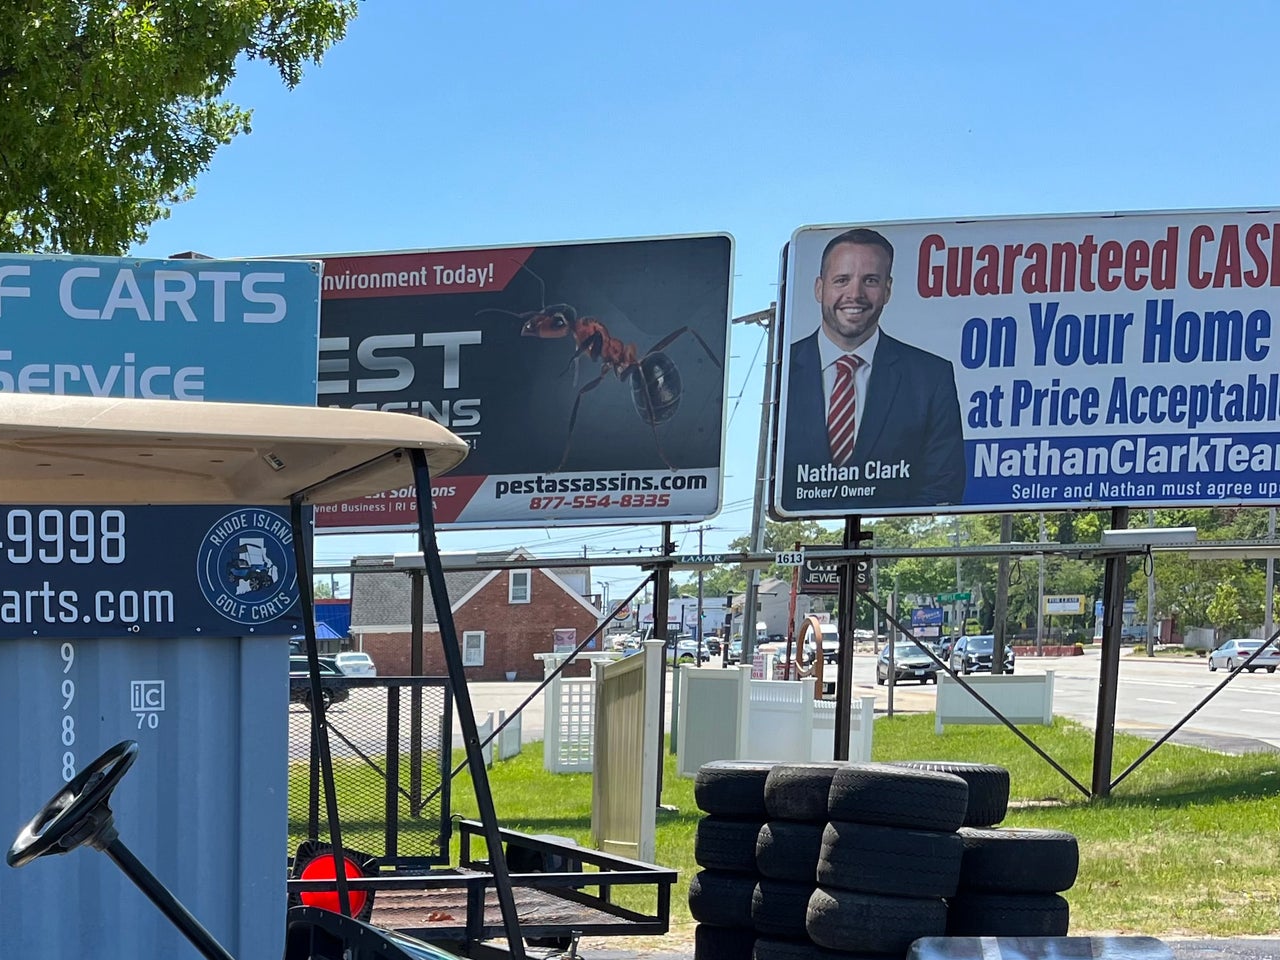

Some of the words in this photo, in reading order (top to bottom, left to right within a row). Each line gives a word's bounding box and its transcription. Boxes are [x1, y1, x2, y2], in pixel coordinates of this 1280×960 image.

[917, 226, 1179, 298] Guaranteed
[320, 266, 427, 291] nvironment
[433, 263, 494, 287] Today!
[59, 267, 287, 323] CARTS
[960, 315, 1017, 369] on
[1029, 302, 1134, 366] Your
[1142, 299, 1271, 363] Home
[318, 330, 482, 394] EST
[967, 385, 1004, 428] at
[1010, 379, 1099, 426] Price
[1105, 374, 1280, 429] Acceptabl
[797, 463, 859, 482] Nathan
[864, 460, 910, 479] Clark
[974, 437, 1280, 478] NathanClarkTea
[495, 473, 707, 498] pestassassins.com
[796, 486, 838, 499] Broker/
[841, 485, 876, 497] Owner
[1012, 484, 1057, 499] Seller
[1064, 483, 1092, 498] and
[1099, 482, 1155, 498] Nathan
[1162, 481, 1201, 496] must
[1207, 482, 1252, 499] agree
[1258, 482, 1280, 498] up
[341, 503, 386, 512] Business
[529, 494, 670, 510] 877-554-8335
[210, 513, 248, 546] RHODE
[253, 513, 294, 545] ISLAND
[777, 554, 803, 563] 1613
[215, 593, 247, 618] GOLF
[251, 592, 291, 620] CARTS
[135, 713, 159, 729] 70
